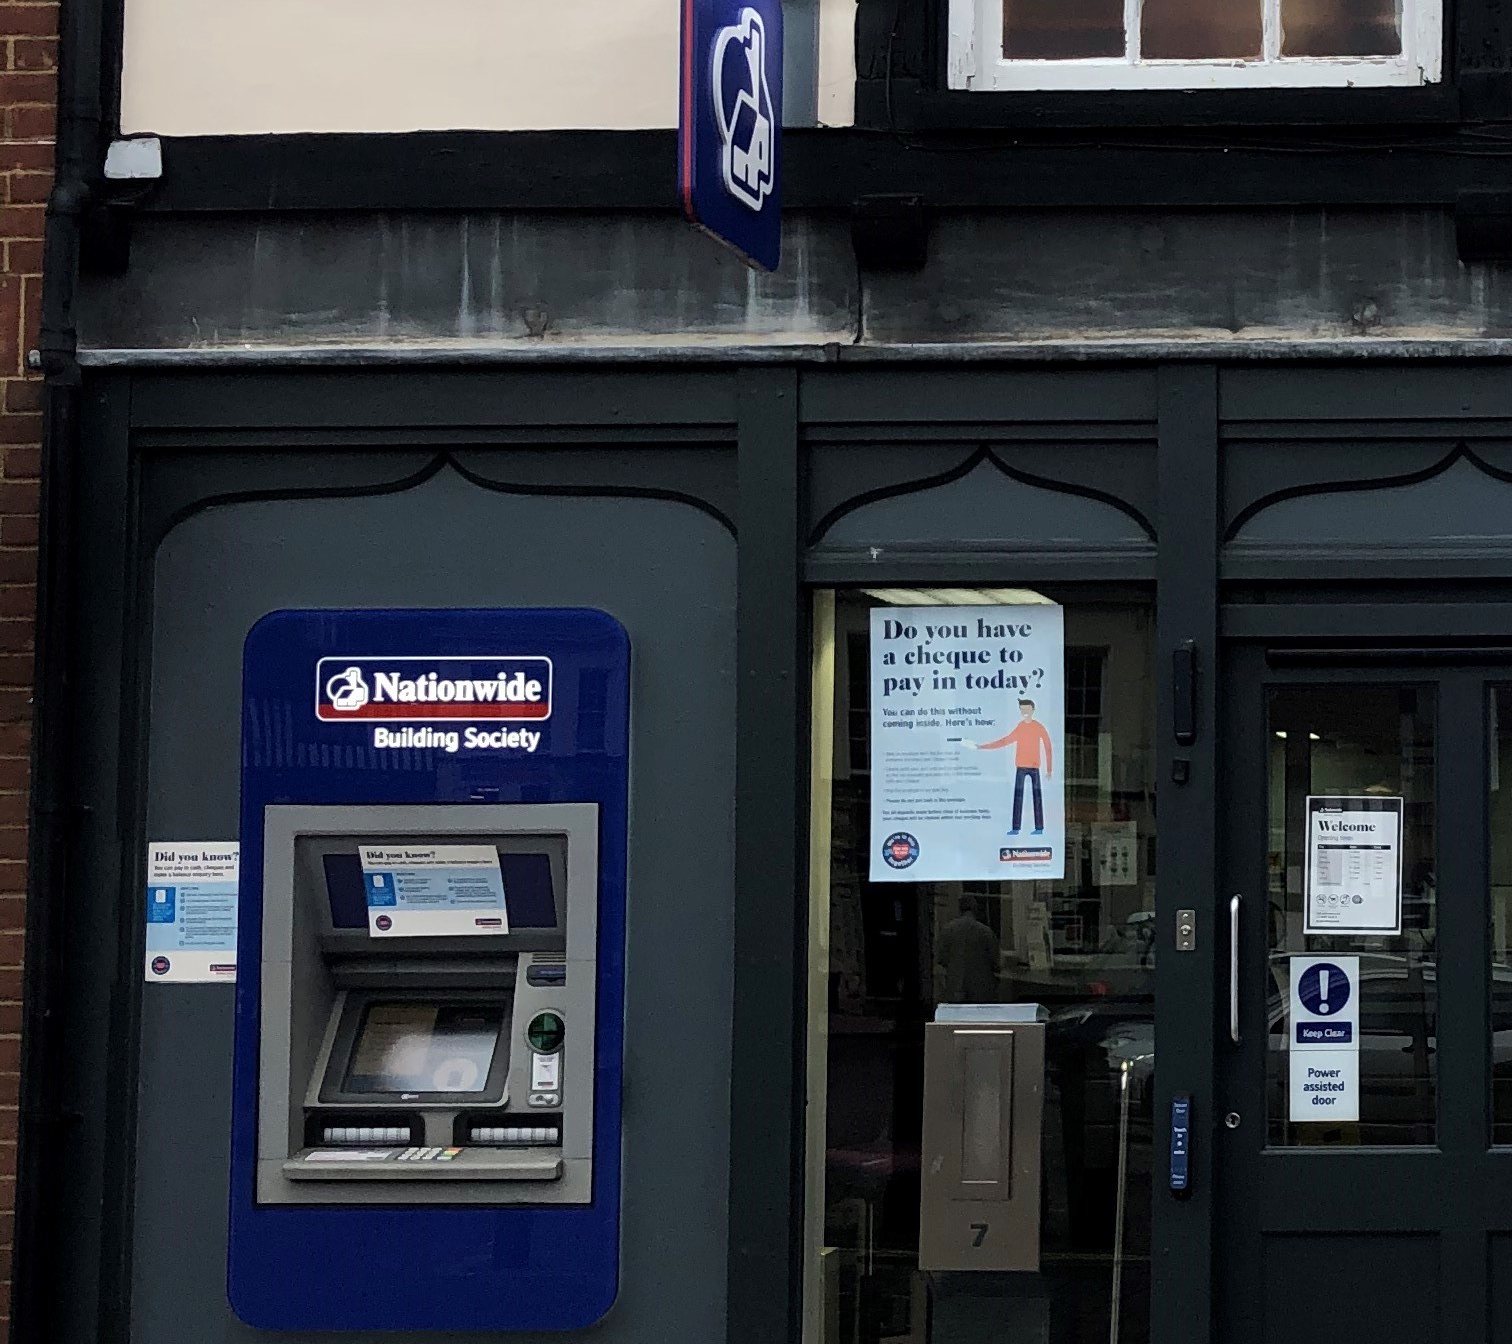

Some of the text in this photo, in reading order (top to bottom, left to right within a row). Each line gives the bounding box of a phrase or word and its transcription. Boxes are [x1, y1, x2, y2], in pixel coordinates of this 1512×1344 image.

[884, 618, 1032, 645] Do you have
[883, 645, 1023, 669] a cheque to
[372, 672, 542, 702] Nationwide
[883, 668, 1044, 696] pay in today?
[883, 708, 897, 716] You
[930, 707, 946, 715] this
[883, 719, 914, 729] coming
[945, 718, 972, 726] Here's
[374, 727, 541, 753] Building Society
[1318, 820, 1376, 832] Welcome
[155, 851, 175, 861] Did
[178, 854, 198, 864] you
[367, 851, 384, 859] Did
[405, 851, 436, 859] know?
[1303, 1028, 1346, 1039] Keep Clear
[1308, 1068, 1341, 1078] Power
[1303, 1081, 1345, 1092] assisted
[1311, 1095, 1337, 1105] door
[970, 1224, 989, 1247] 7
